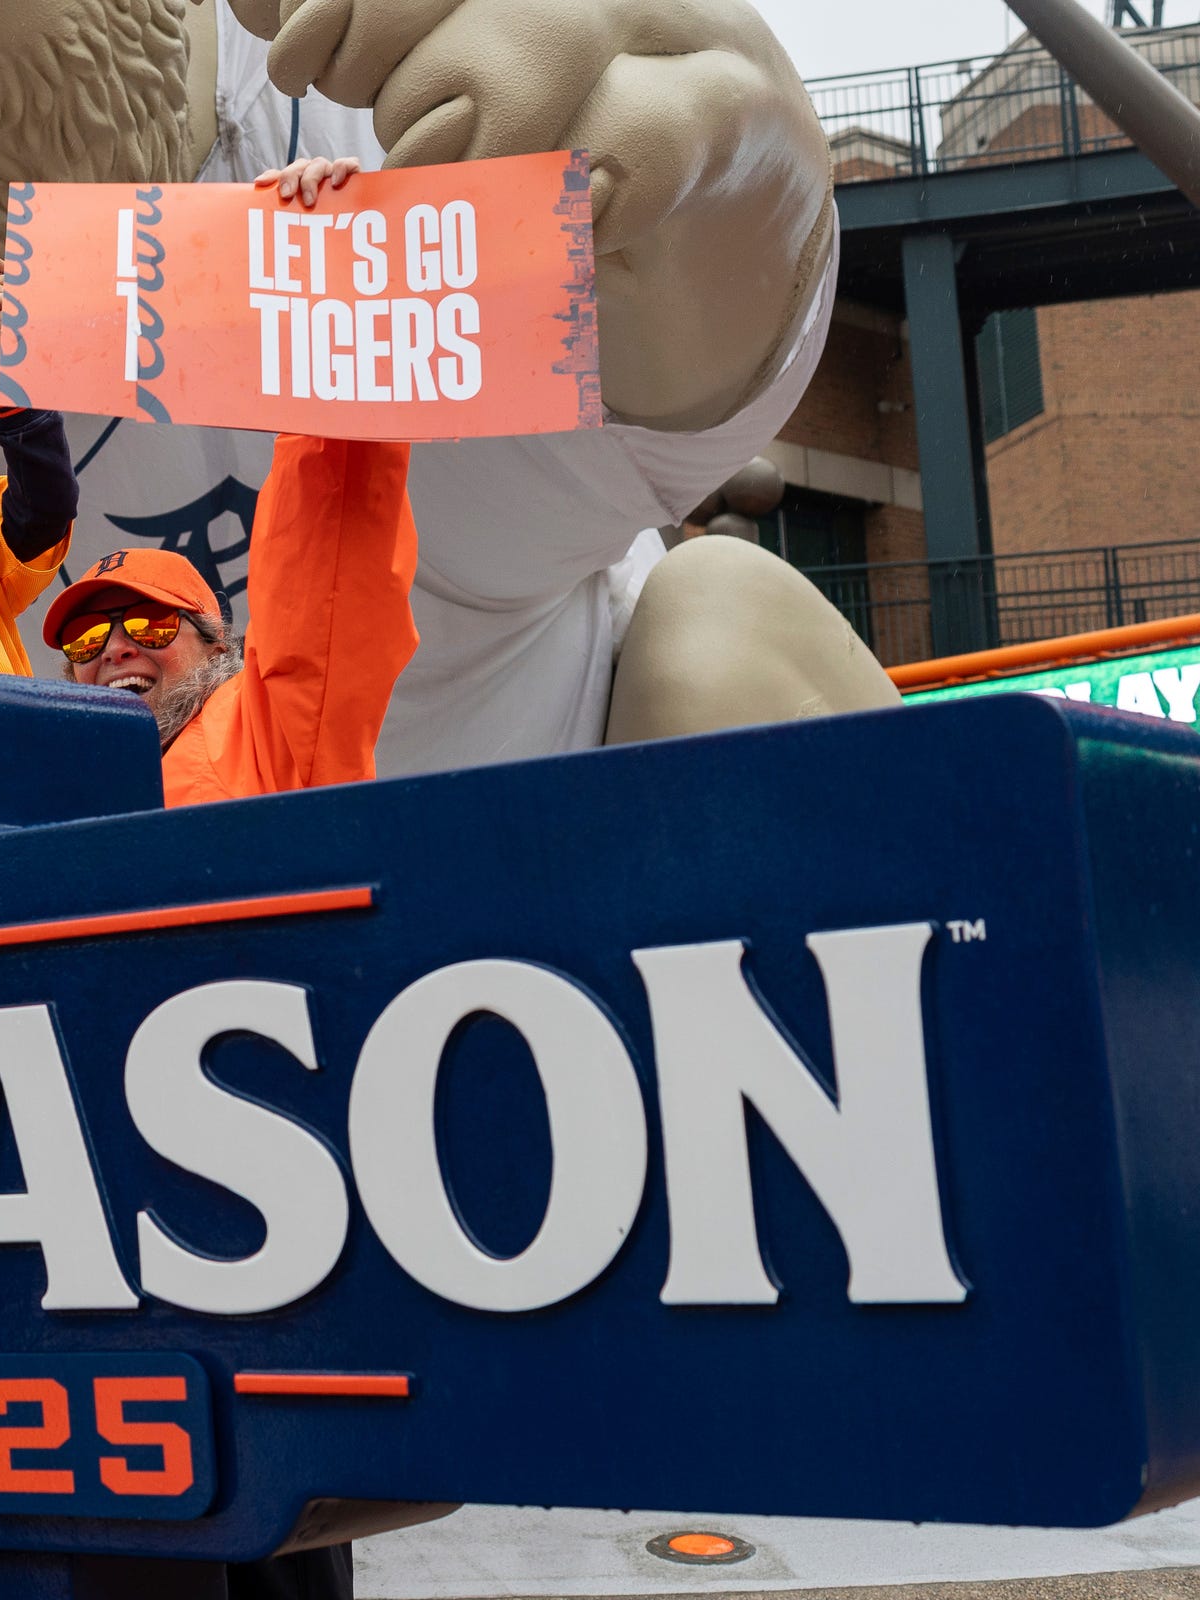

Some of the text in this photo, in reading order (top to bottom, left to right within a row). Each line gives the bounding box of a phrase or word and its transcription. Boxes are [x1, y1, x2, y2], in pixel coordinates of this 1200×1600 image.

[248, 200, 478, 296] LET'S GO
[249, 293, 482, 402] TIGERS
